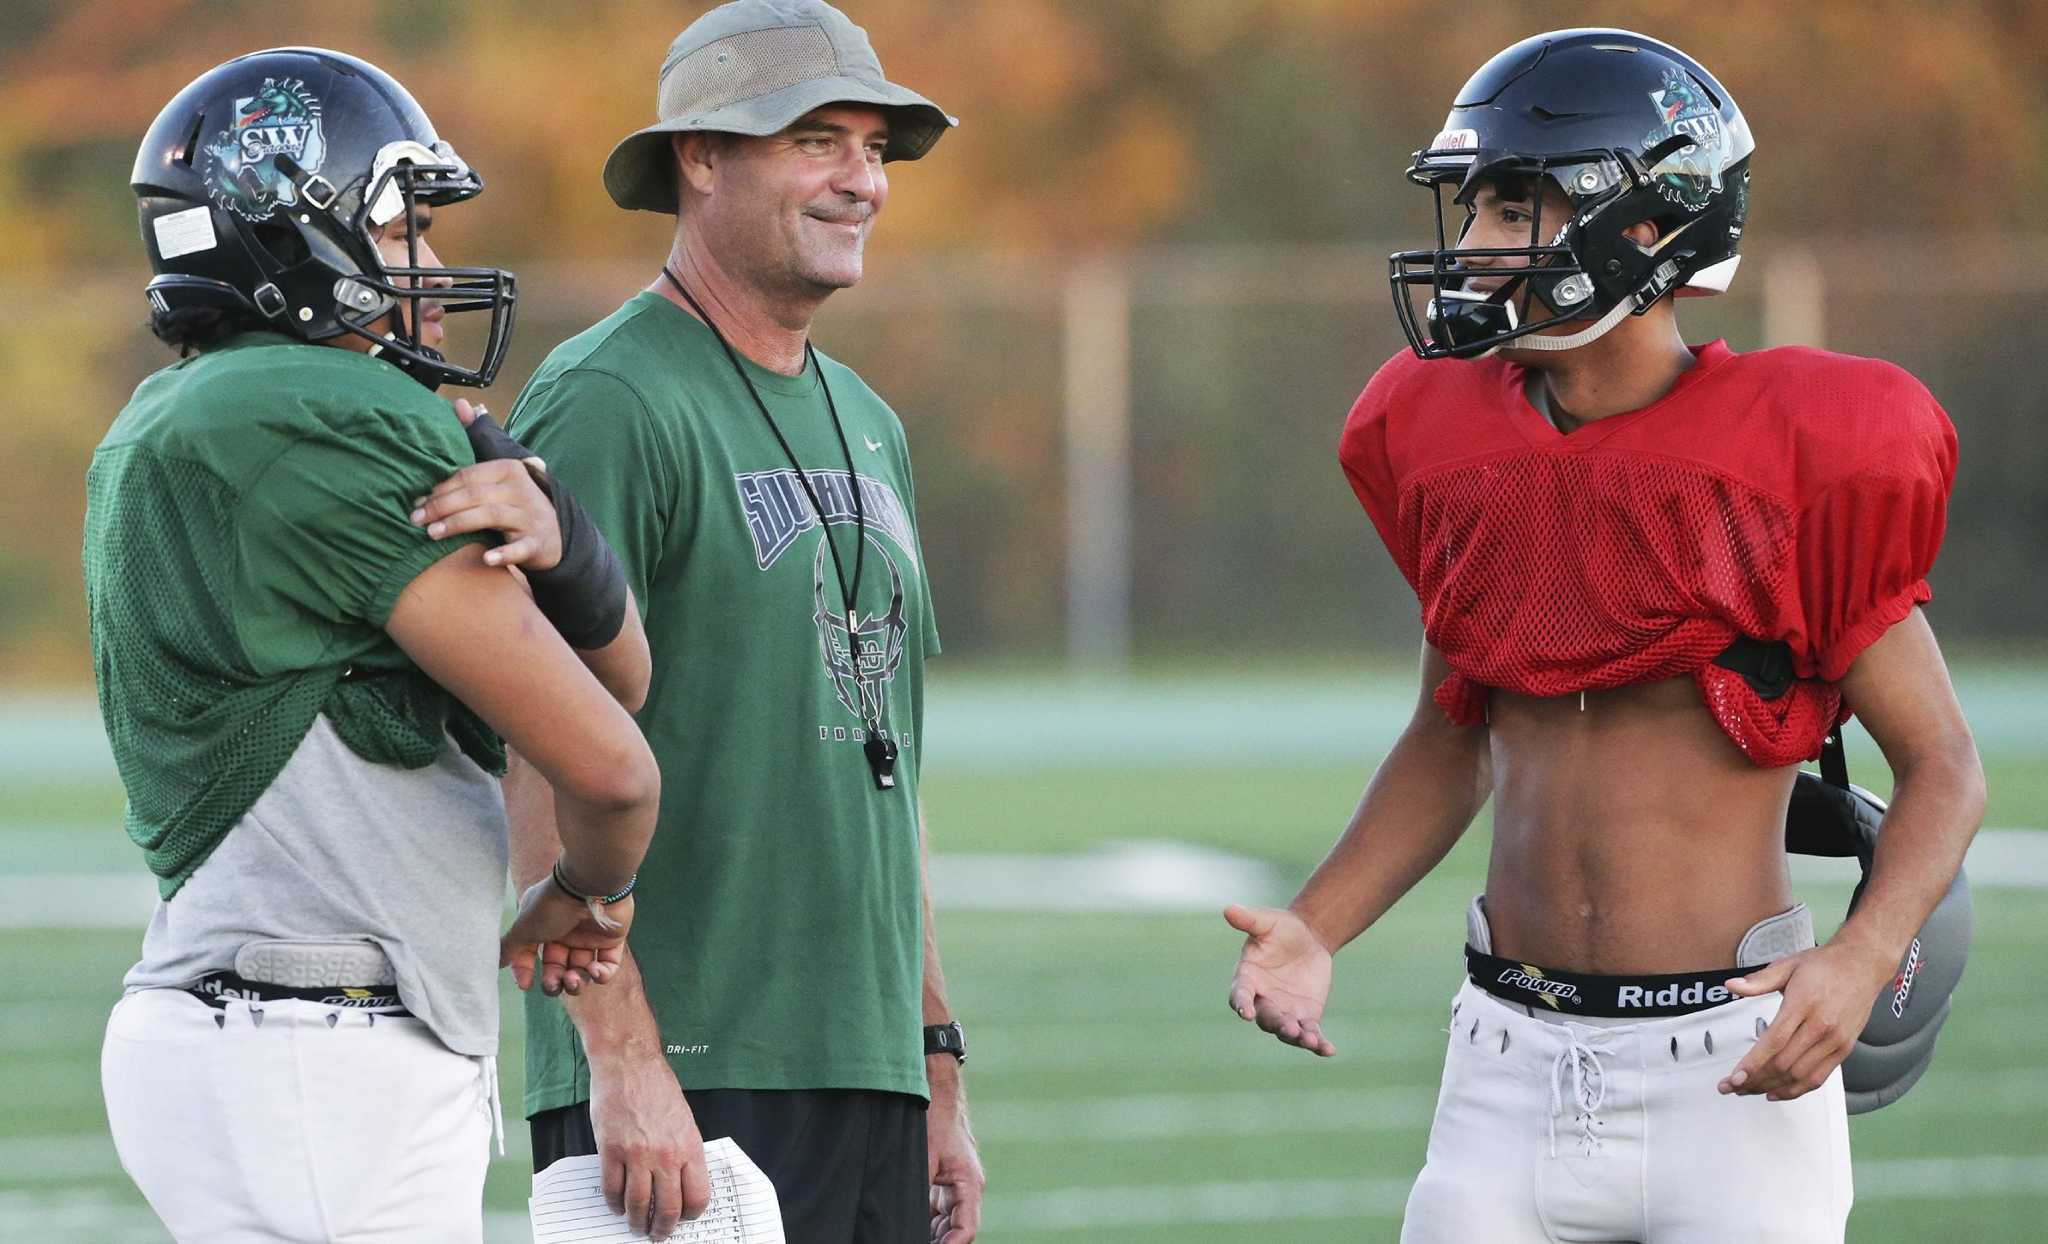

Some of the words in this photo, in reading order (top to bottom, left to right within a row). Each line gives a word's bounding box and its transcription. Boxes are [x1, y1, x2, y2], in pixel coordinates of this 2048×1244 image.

[241, 126, 312, 163] SW
[1497, 968, 1577, 998] POWER
[1618, 982, 1740, 1008] Ridde
[666, 1045, 710, 1054] DRI-FIT
